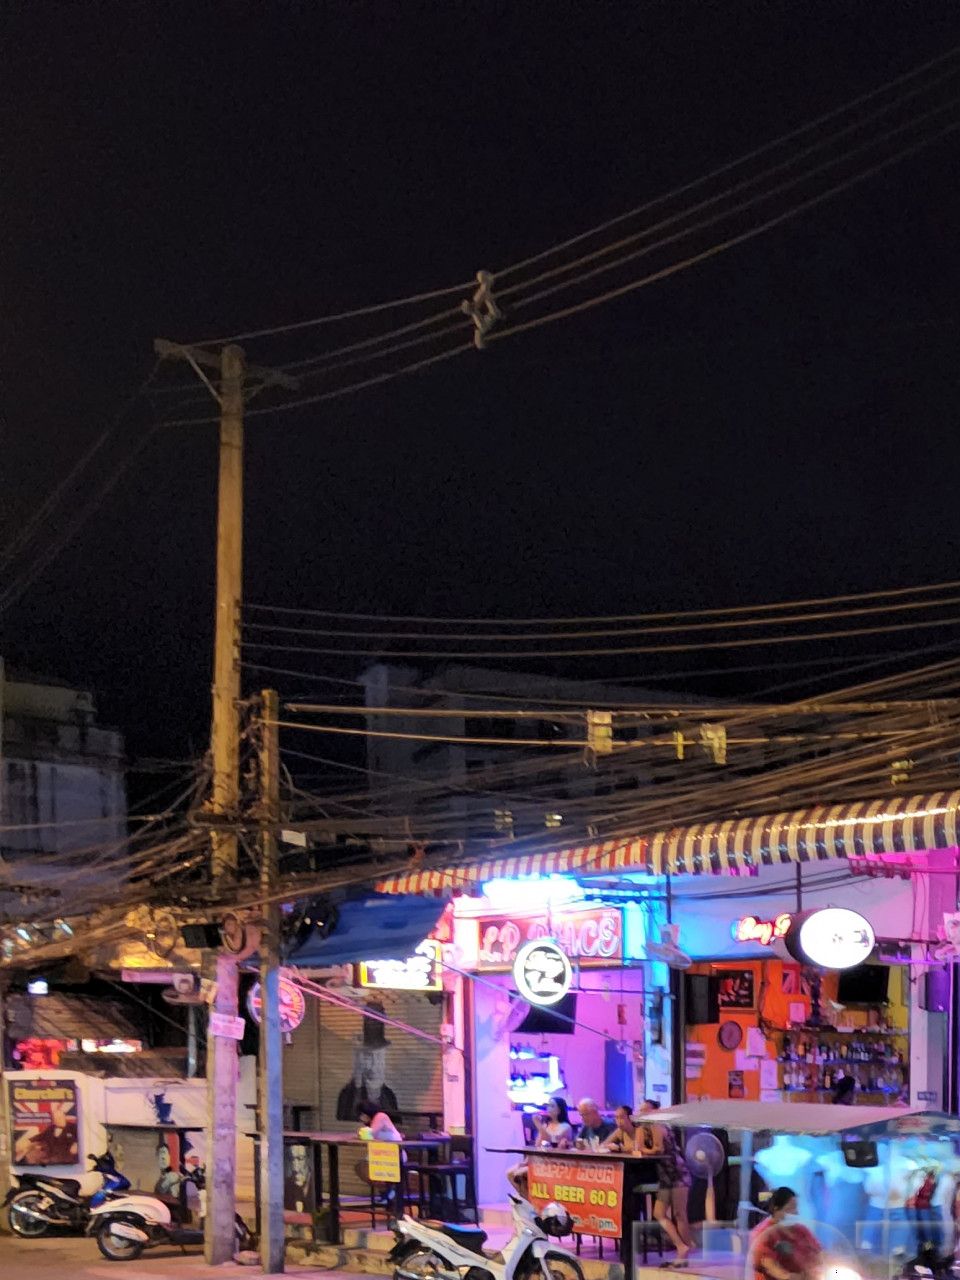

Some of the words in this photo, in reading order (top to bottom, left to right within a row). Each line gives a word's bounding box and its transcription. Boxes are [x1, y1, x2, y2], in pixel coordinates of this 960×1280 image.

[532, 1156, 574, 1180] HAPPY
[576, 1162, 616, 1184] HOUR
[530, 1182, 550, 1199] ALL
[554, 1184, 585, 1203] BEER
